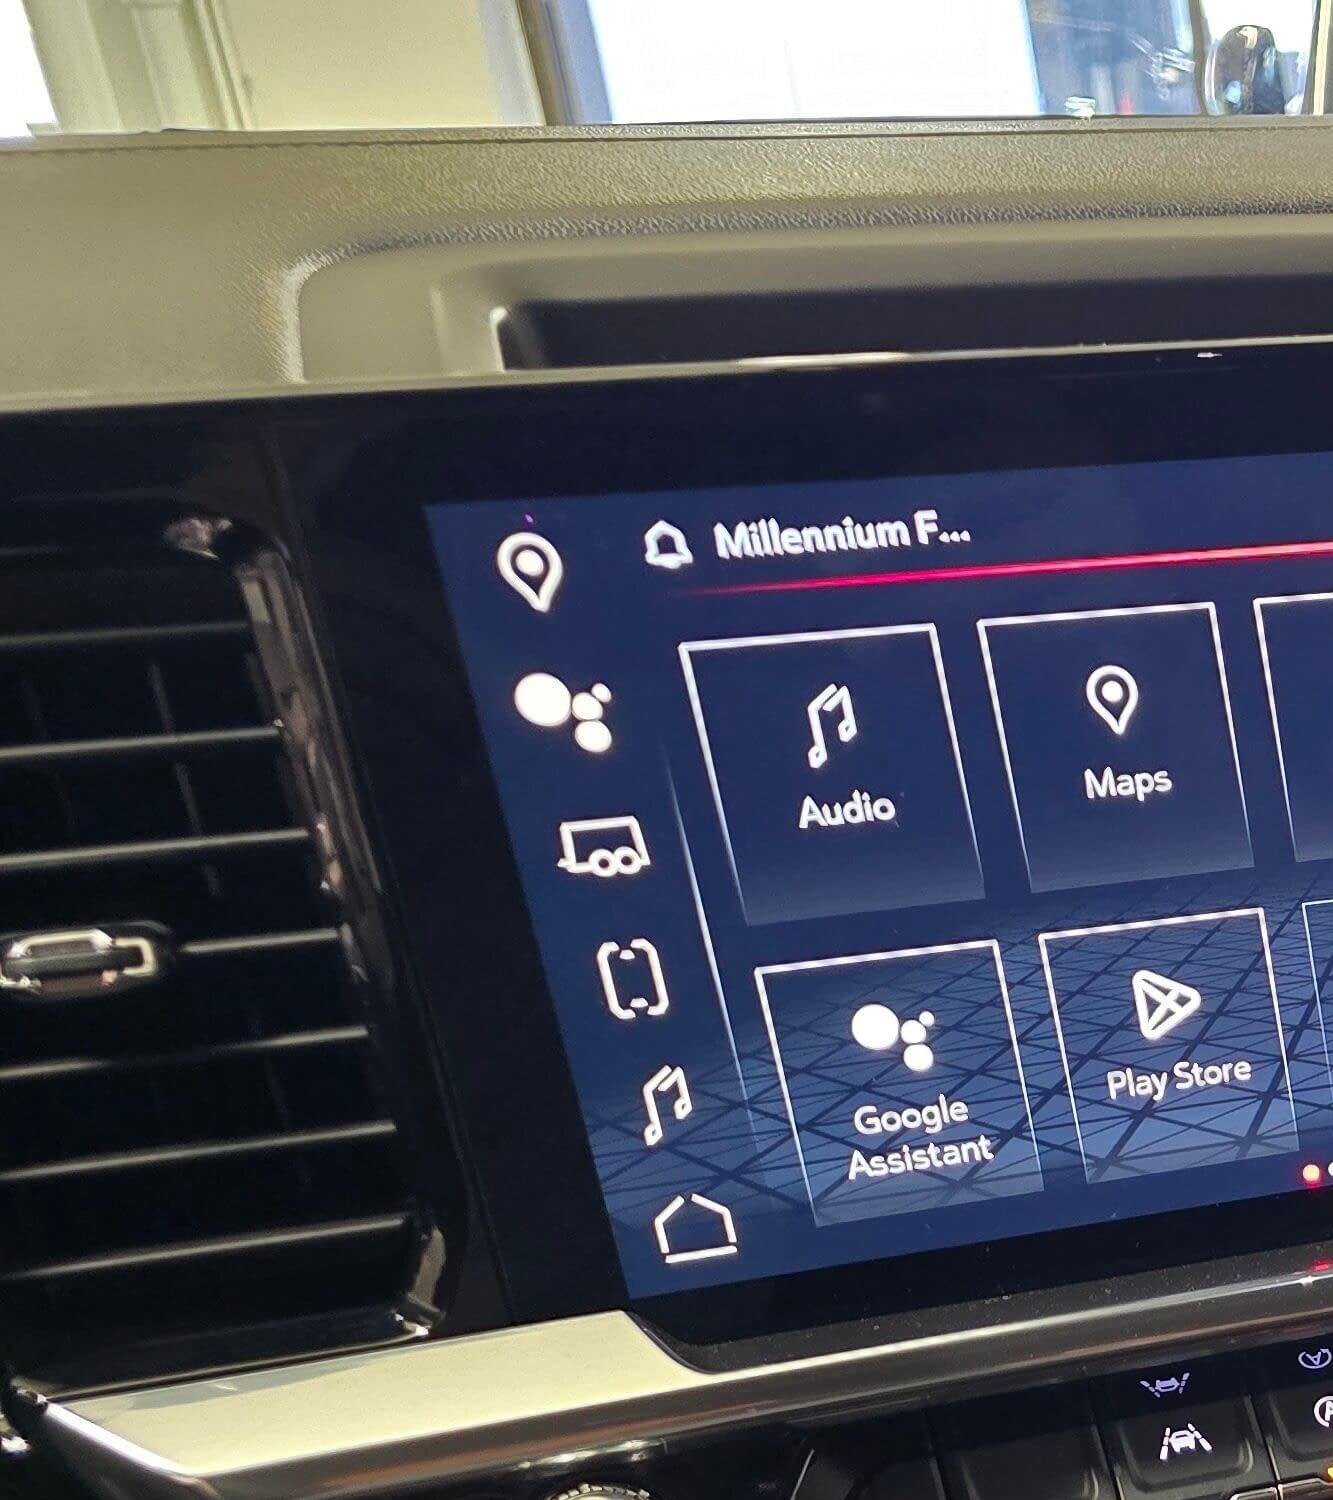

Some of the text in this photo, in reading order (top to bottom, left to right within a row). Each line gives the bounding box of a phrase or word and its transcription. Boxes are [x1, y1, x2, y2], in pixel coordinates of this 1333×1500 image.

[714, 516, 910, 559] Millennium
[1085, 767, 1172, 801] Maps
[799, 790, 895, 828] Audio
[1107, 1062, 1251, 1100] Play Store
[855, 1094, 968, 1134] Google
[849, 1135, 995, 1180] Assistant
